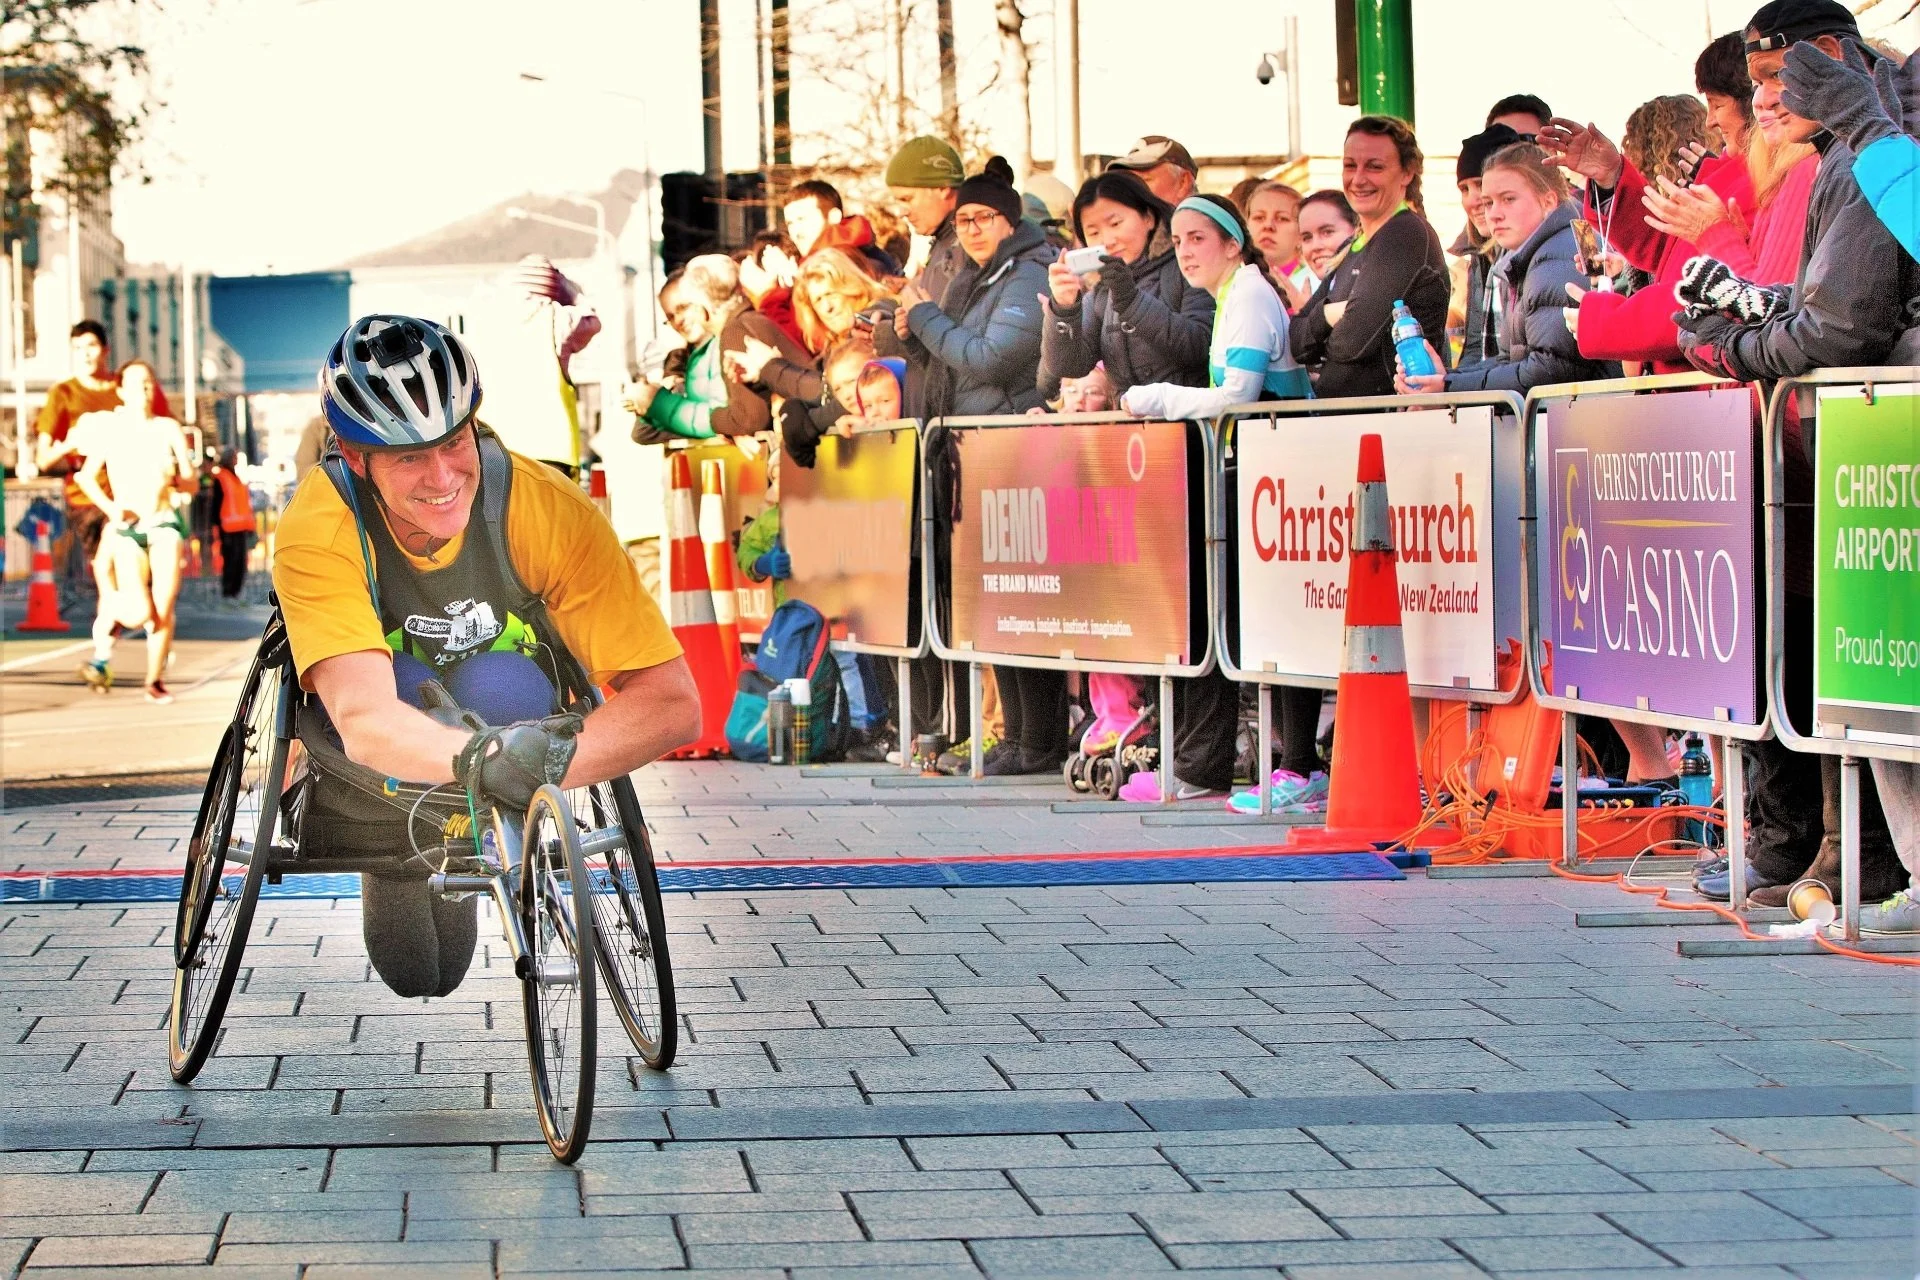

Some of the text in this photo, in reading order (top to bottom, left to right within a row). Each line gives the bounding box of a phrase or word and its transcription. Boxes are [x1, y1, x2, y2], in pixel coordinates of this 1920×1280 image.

[1594, 450, 1737, 502] CHRISTCHURCH
[1252, 472, 1478, 563] Christurch
[983, 574, 1060, 594] THE BRAND MAKERS
[1304, 578, 1325, 609] The
[1401, 583, 1427, 613] New
[1429, 581, 1479, 615] Zealand
[1600, 544, 1739, 663] CASINO
[1835, 626, 1920, 678] Proud spo
